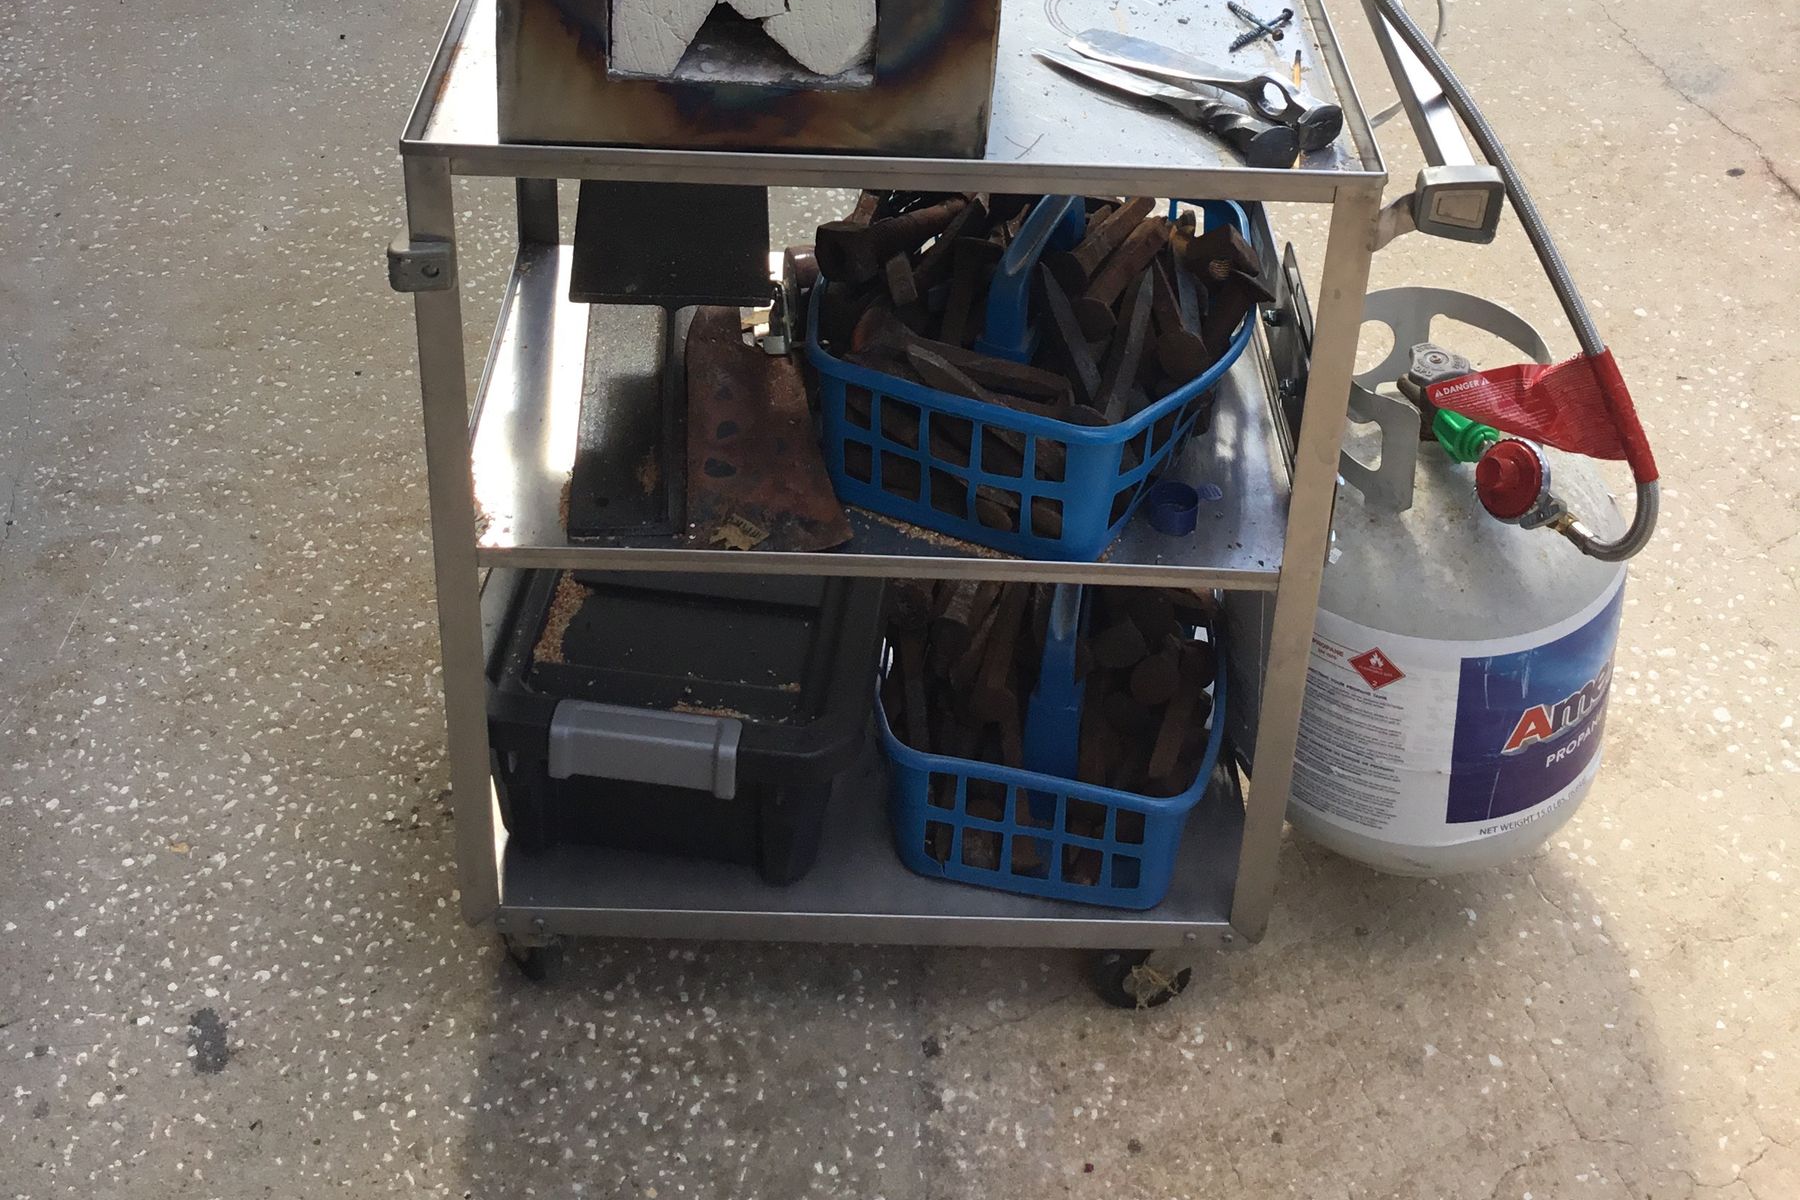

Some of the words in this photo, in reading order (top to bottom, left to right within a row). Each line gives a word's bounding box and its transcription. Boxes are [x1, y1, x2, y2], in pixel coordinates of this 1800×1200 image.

[1443, 380, 1480, 395] DANGER
[1479, 826, 1498, 835] NET
[1500, 814, 1535, 831] WEIGHT
